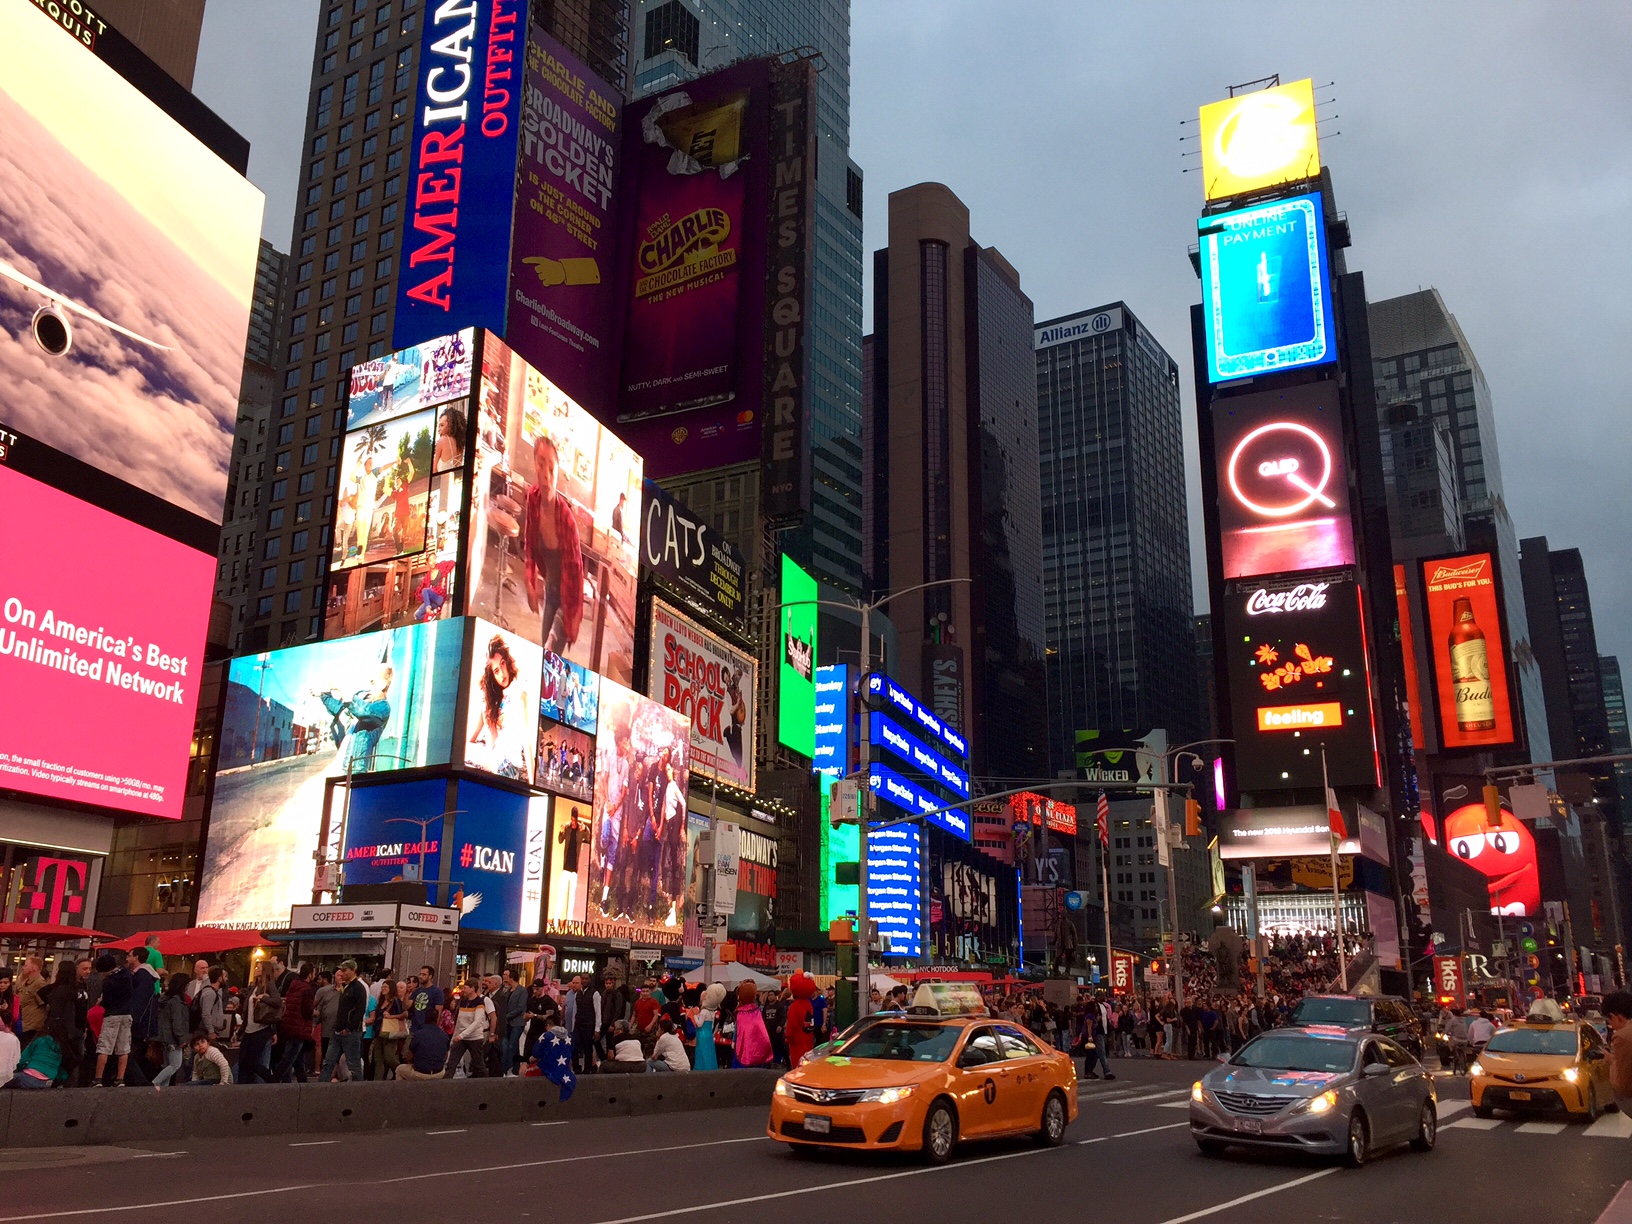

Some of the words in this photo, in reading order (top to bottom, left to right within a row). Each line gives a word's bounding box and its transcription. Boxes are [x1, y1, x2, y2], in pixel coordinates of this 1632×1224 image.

[62, 0, 107, 35] OTT
[530, 40, 586, 94] CHARLIE
[589, 89, 617, 118] AND
[530, 55, 539, 73] HE
[541, 65, 584, 107] CHOCOLATE
[585, 99, 616, 132] FACTORY
[526, 83, 614, 168] BROADWAY'S
[407, 0, 478, 312] AMERICAN
[524, 107, 613, 189] GOLDEN
[524, 129, 612, 211] TICKET
[774, 97, 802, 248] TIMES
[529, 171, 539, 184] IS
[541, 175, 565, 202] JUST
[566, 190, 601, 229] AROUND
[538, 190, 558, 209] THE
[557, 200, 592, 236] CORNER
[529, 199, 544, 216] ON
[567, 221, 599, 251] STREET
[1223, 220, 1298, 247] PAYMENT
[1230, 211, 1288, 232] ONLINE
[641, 209, 725, 270] CHARLIE
[648, 262, 697, 290] CHOCOLATE
[699, 250, 734, 272] FACTORY
[647, 292, 664, 305] THE
[666, 285, 685, 299] NEW
[687, 271, 725, 290] MUSICAL
[515, 289, 600, 349] CharlieOnBroadway.com
[1039, 321, 1090, 345] Allianz
[771, 264, 802, 461] SQUARE
[627, 381, 652, 392] NUTTY,
[652, 376, 672, 387] DARK
[684, 365, 729, 381] SEMI-SWEET
[1258, 458, 1300, 478] QLED
[646, 498, 708, 570] CATS
[722, 540, 732, 555] ON
[712, 544, 742, 577] BROADWAY
[713, 560, 739, 588] THROUGH
[1436, 566, 1481, 579] Budweiser
[709, 571, 736, 599] DECEMBER
[1246, 582, 1330, 616] Coca-Cola
[1429, 584, 1443, 593] THIS
[1443, 582, 1463, 590] BUD'S
[1463, 580, 1476, 588] FOR
[4, 597, 36, 629] On
[39, 609, 143, 663] America's
[146, 639, 188, 677] Best
[674, 620, 687, 636] LLOYD
[687, 625, 704, 648] WEBBER
[0, 627, 102, 681] Unlimited
[106, 662, 185, 705] Network
[664, 631, 726, 696] SCHOOL
[787, 639, 811, 668] StubHub
[664, 672, 724, 746] ROCK
[1264, 708, 1324, 727] feeling
[11, 754, 23, 764] the
[23, 757, 41, 768] small
[41, 759, 66, 773] fraction
[66, 765, 73, 774] of
[73, 768, 104, 781] customers
[104, 774, 120, 786] using
[153, 784, 165, 793] may
[31, 768, 50, 781] Video
[50, 771, 76, 787] typically
[76, 777, 100, 790] streams
[100, 783, 109, 792] on
[109, 785, 143, 798] smartphone
[1055, 811, 1075, 824] PLAZA
[1232, 828, 1247, 837] The
[1247, 829, 1264, 837] new
[1282, 826, 1315, 837] Hyundai
[1315, 825, 1330, 834] Son
[346, 843, 403, 859] AMERICAN
[404, 840, 439, 855] EAGLE
[371, 857, 409, 867] OUTFITTERS
[460, 845, 514, 875] #ICAN
[717, 853, 731, 861] DEAR
[717, 860, 730, 868] EVAN
[526, 828, 544, 903] #ICAN
[717, 867, 738, 876] HANSEN
[753, 863, 777, 898] THING
[1034, 857, 1060, 882] Y'S
[235, 921, 260, 930] EAGLE
[312, 911, 354, 922] COFFEED
[408, 911, 438, 923] COFFEED
[547, 918, 604, 938] AMERICAN
[606, 924, 634, 939] EAGLE
[635, 928, 684, 946] OUTFITTERS
[563, 958, 596, 974] DRINK
[919, 965, 931, 973] NYC
[931, 965, 959, 973] HOTDOGS
[1115, 959, 1126, 987] tkts
[1440, 959, 1458, 991] tkts
